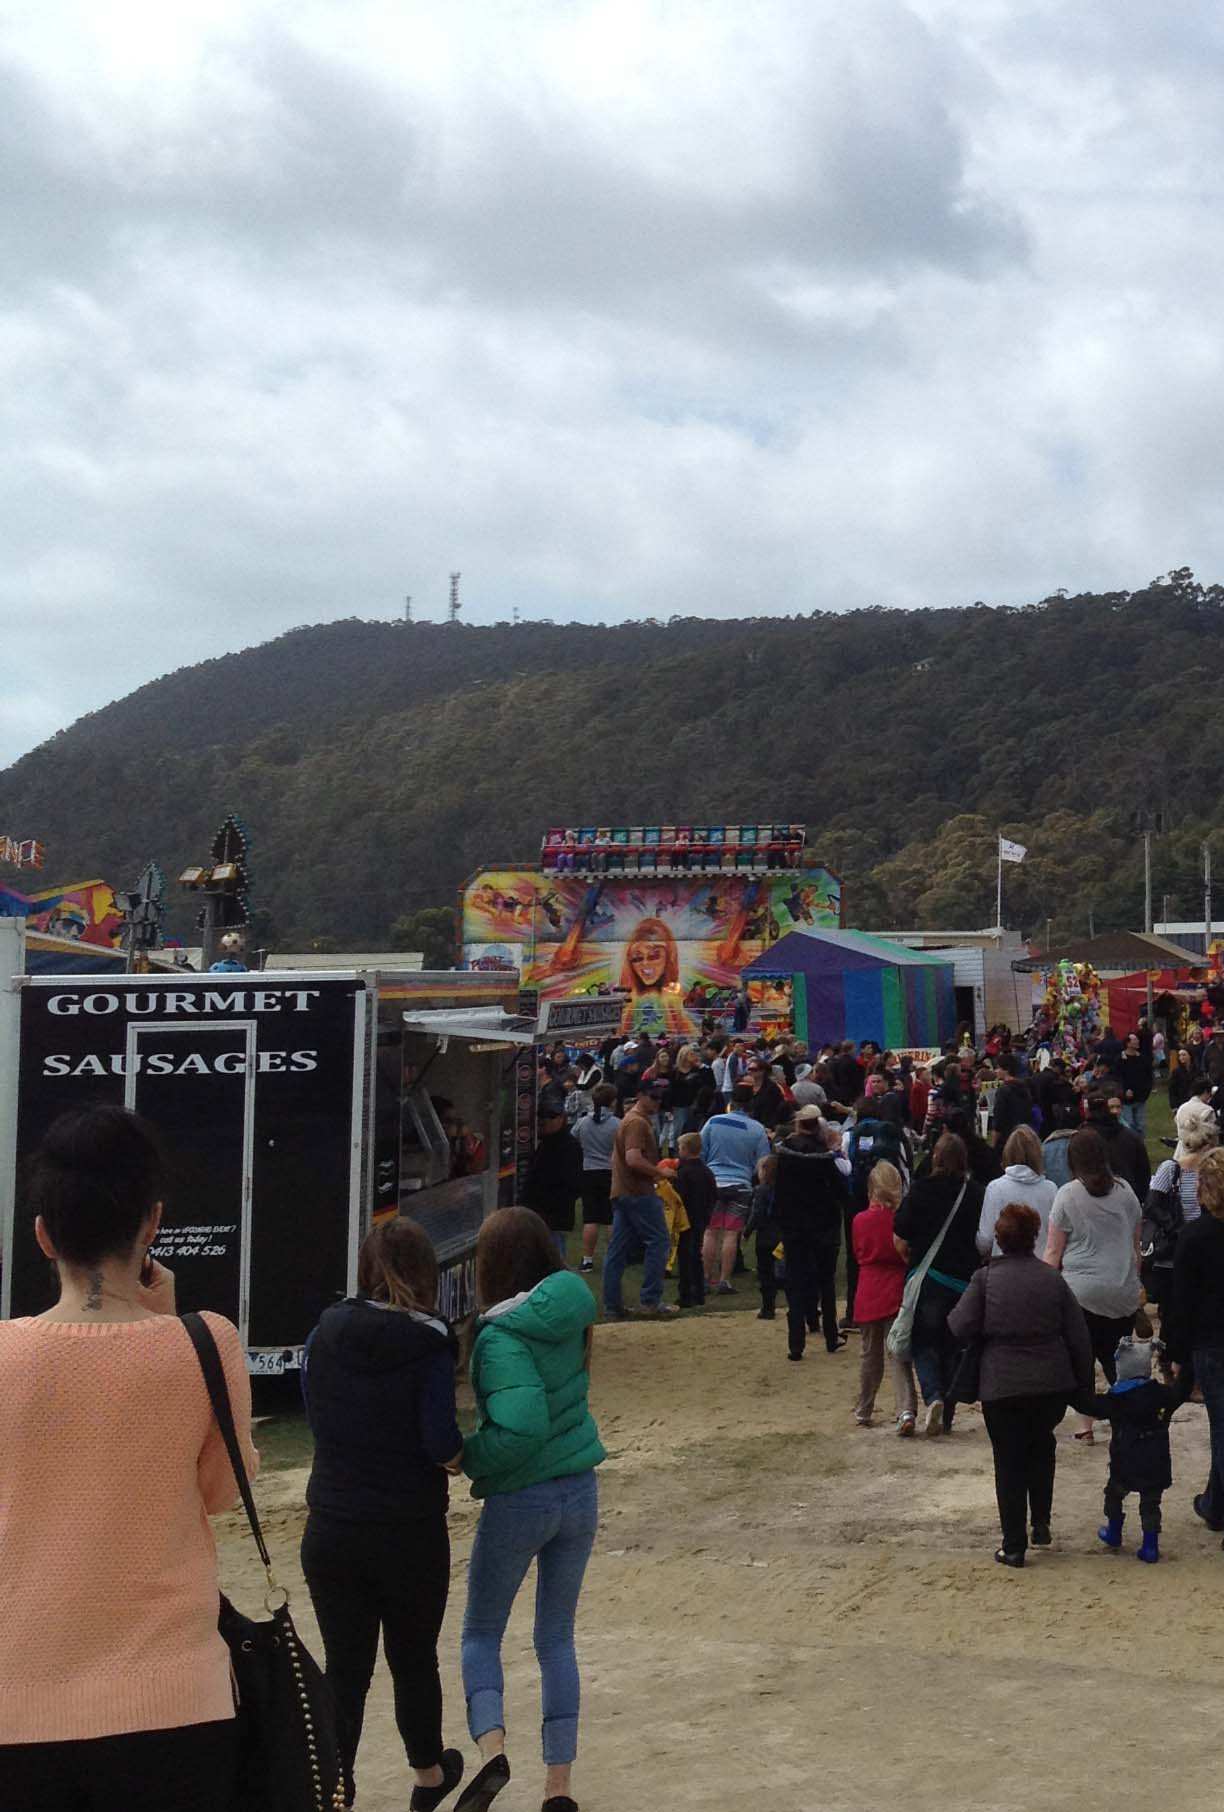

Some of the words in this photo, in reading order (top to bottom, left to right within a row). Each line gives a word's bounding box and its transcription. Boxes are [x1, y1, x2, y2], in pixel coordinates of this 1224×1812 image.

[47, 990, 320, 1015] GOURMET
[43, 1051, 318, 1076] SAUSAGES
[176, 1246, 200, 1257] 404
[201, 1245, 227, 1256] 526
